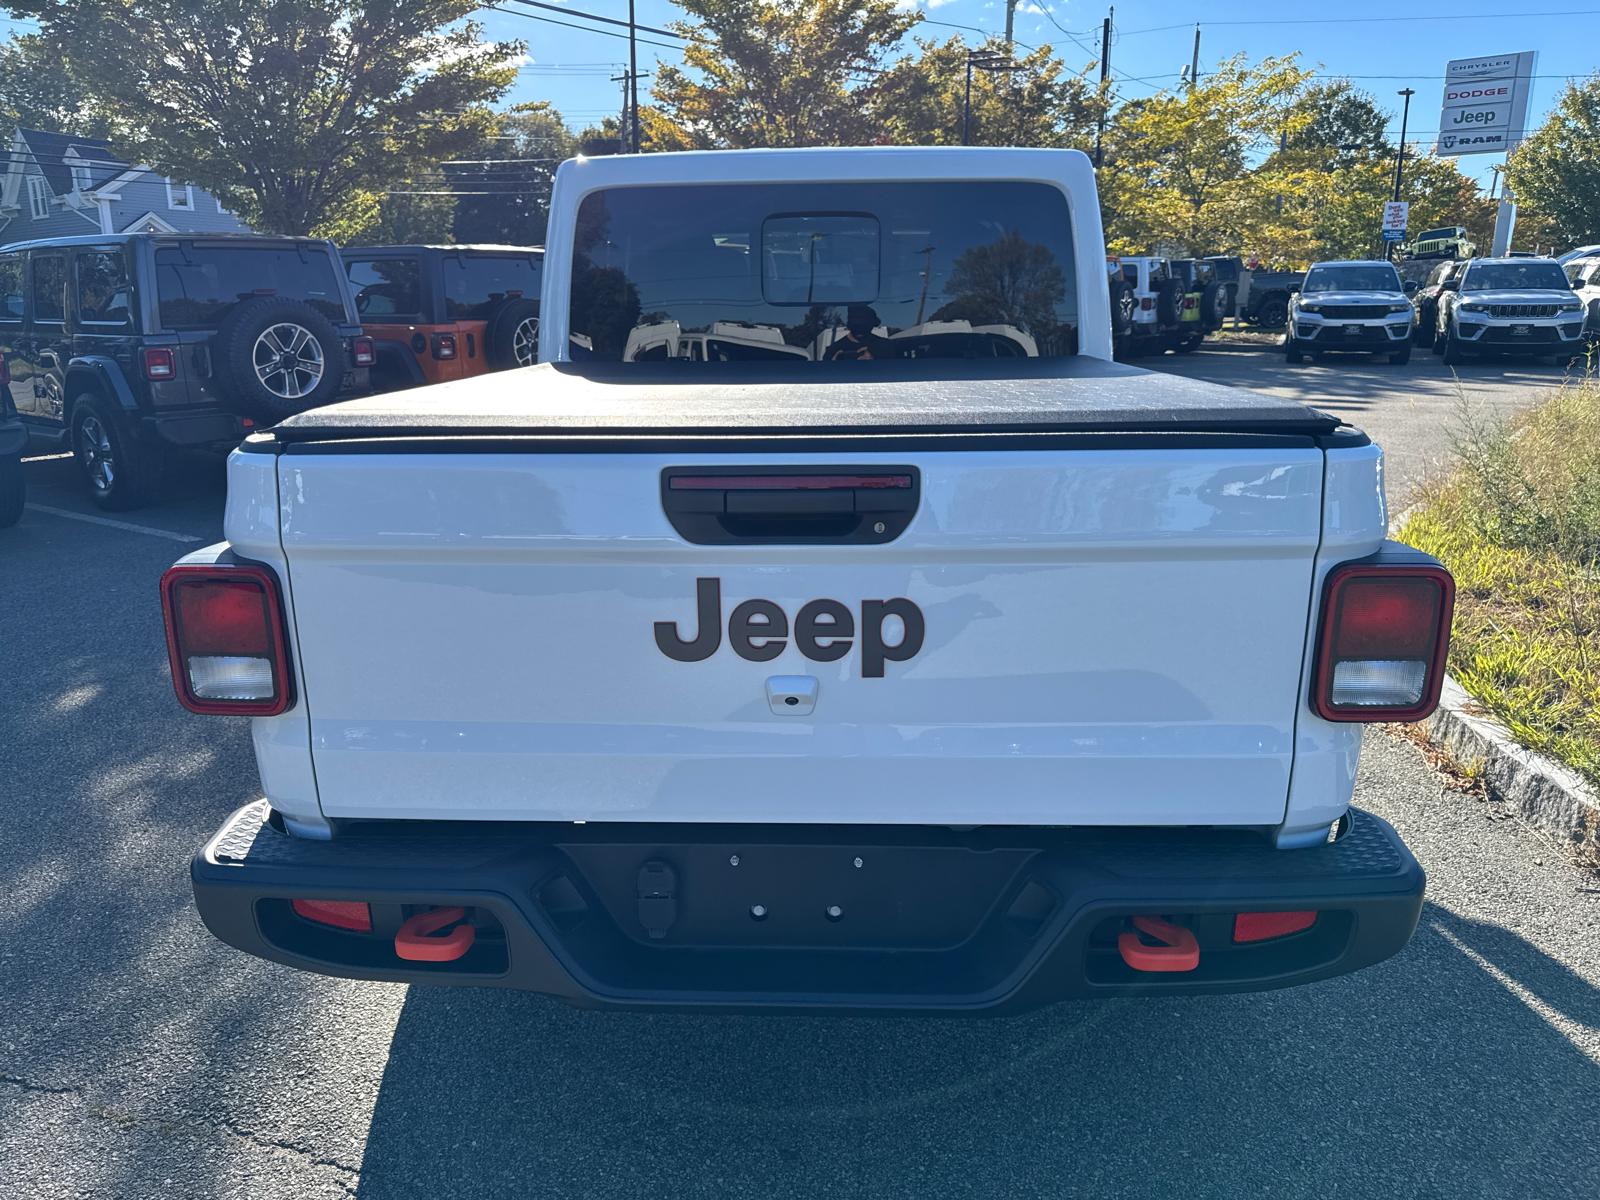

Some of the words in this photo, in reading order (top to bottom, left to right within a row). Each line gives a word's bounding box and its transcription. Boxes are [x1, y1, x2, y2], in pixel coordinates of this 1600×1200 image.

[1452, 60, 1510, 71] CHRYSLER
[1447, 87, 1508, 100] DODGE
[1453, 110, 1496, 124] Jeep
[1459, 135, 1502, 145] RAM
[654, 577, 925, 678] Jeep
